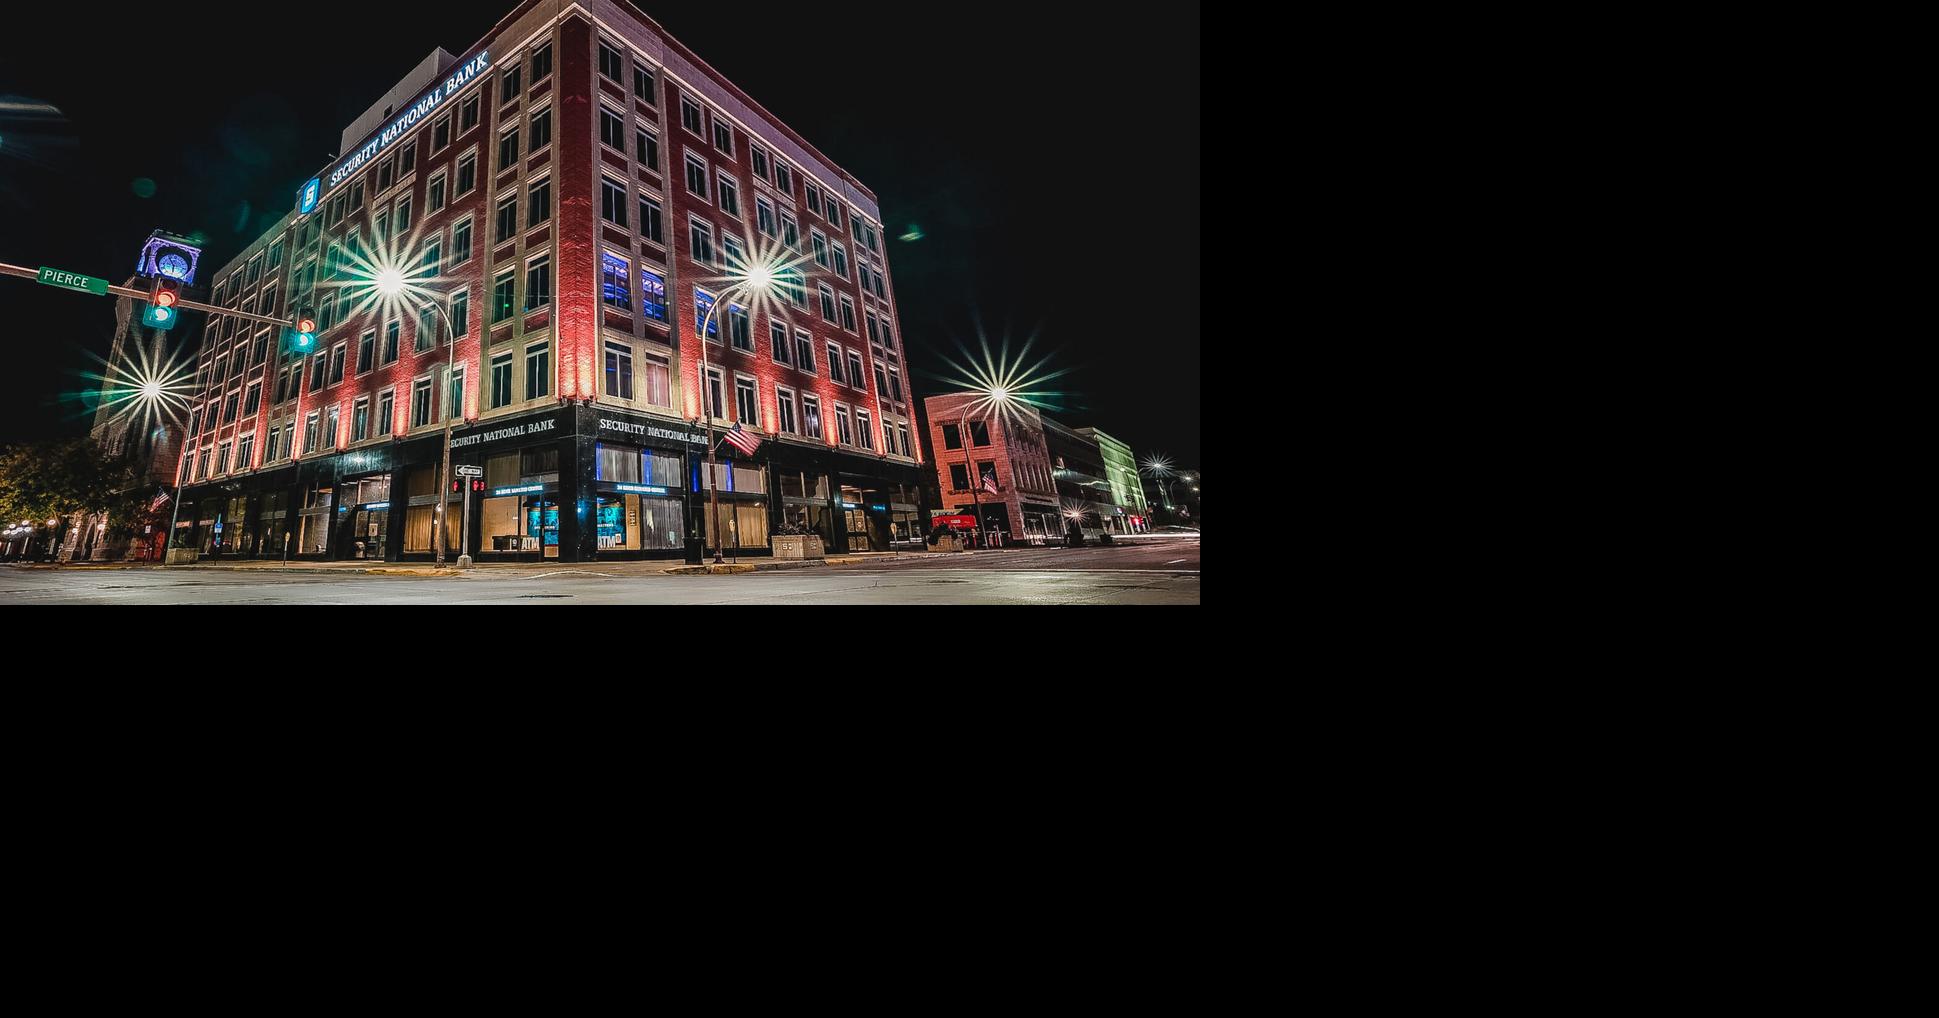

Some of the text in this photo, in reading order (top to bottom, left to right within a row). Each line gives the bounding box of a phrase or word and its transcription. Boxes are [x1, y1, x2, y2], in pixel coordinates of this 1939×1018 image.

[330, 50, 489, 187] SECURITY NATIONAL BANK
[44, 270, 89, 288] PIERCE
[450, 419, 555, 448] ECURITY NATIONAL BANK
[599, 418, 709, 445] SECURITY NATIONAL BAN
[521, 536, 540, 550] ATM
